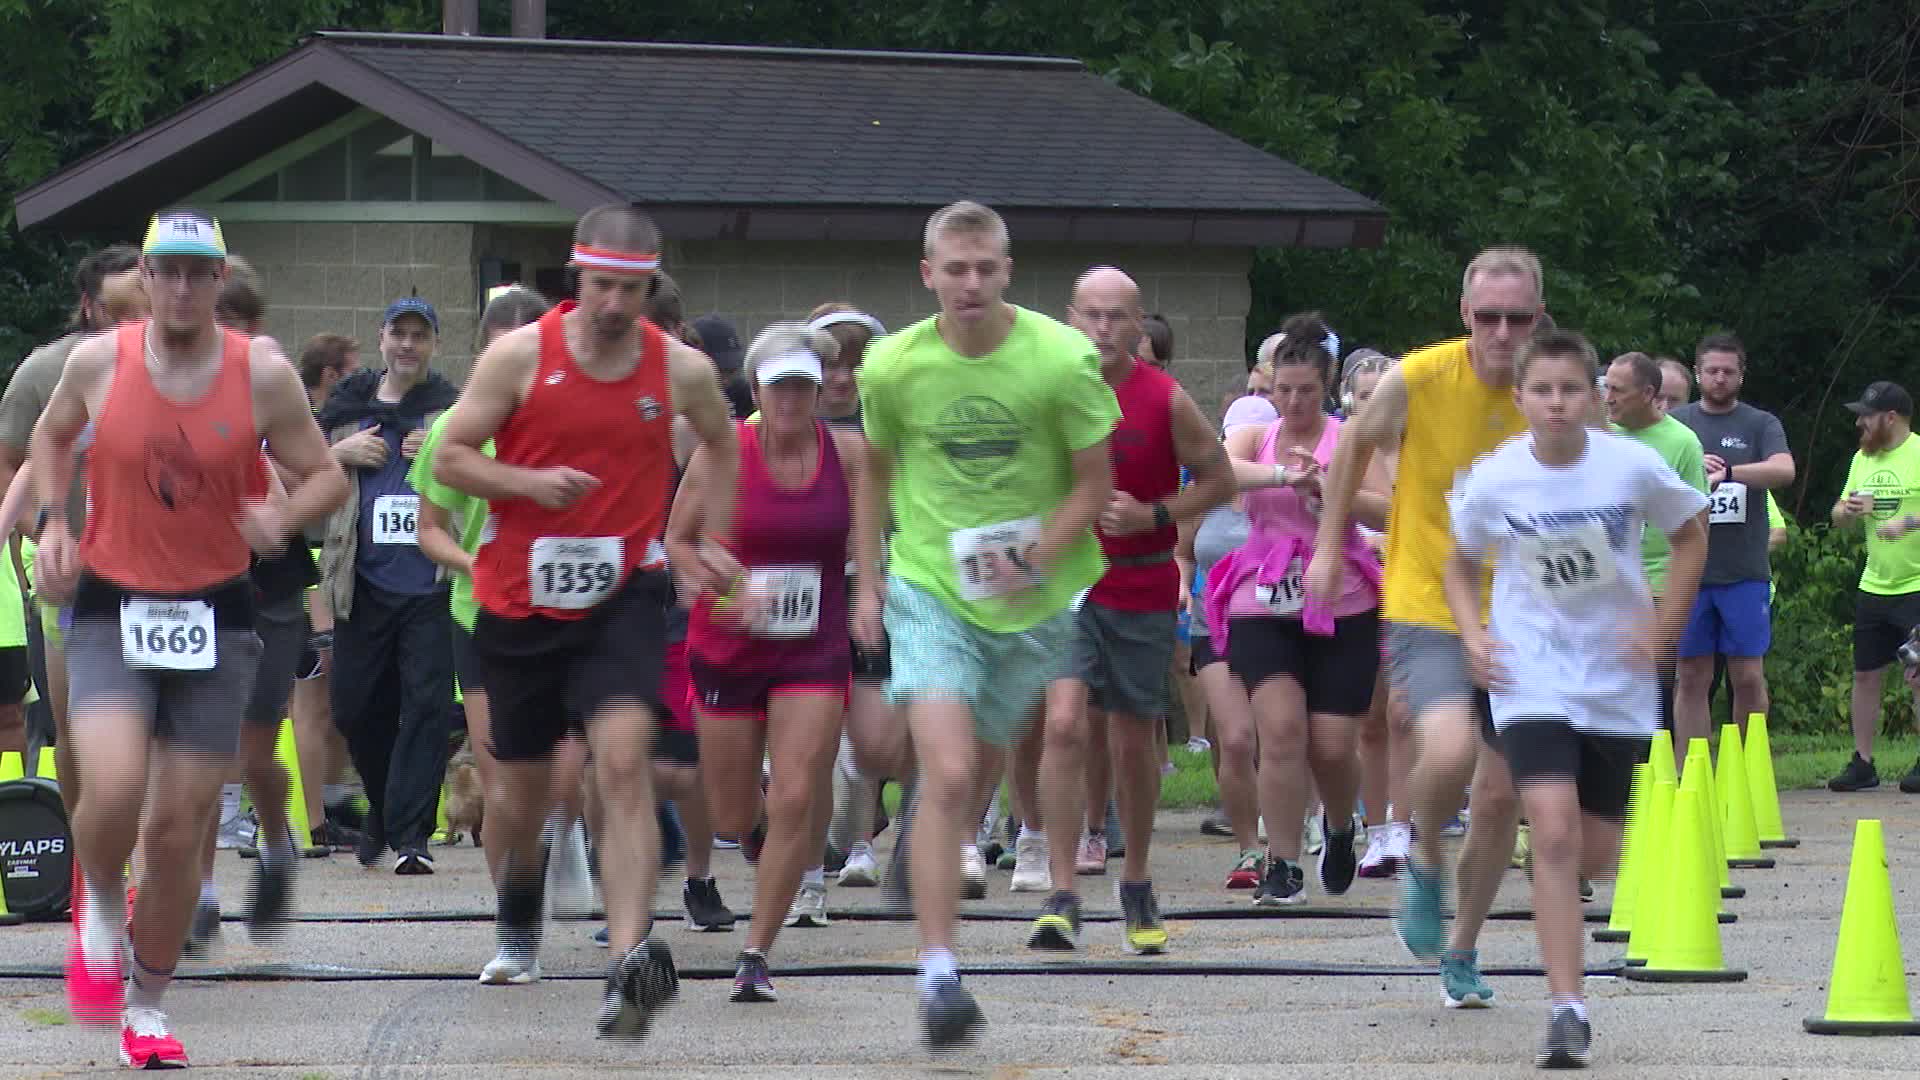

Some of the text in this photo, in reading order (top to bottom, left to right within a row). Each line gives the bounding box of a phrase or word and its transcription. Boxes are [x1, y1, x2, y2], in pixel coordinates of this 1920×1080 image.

[1710, 496, 1739, 514] 254
[379, 511, 417, 533] 136
[538, 562, 615, 594] 1359
[1536, 548, 1600, 588] 202
[128, 624, 207, 654] 1669
